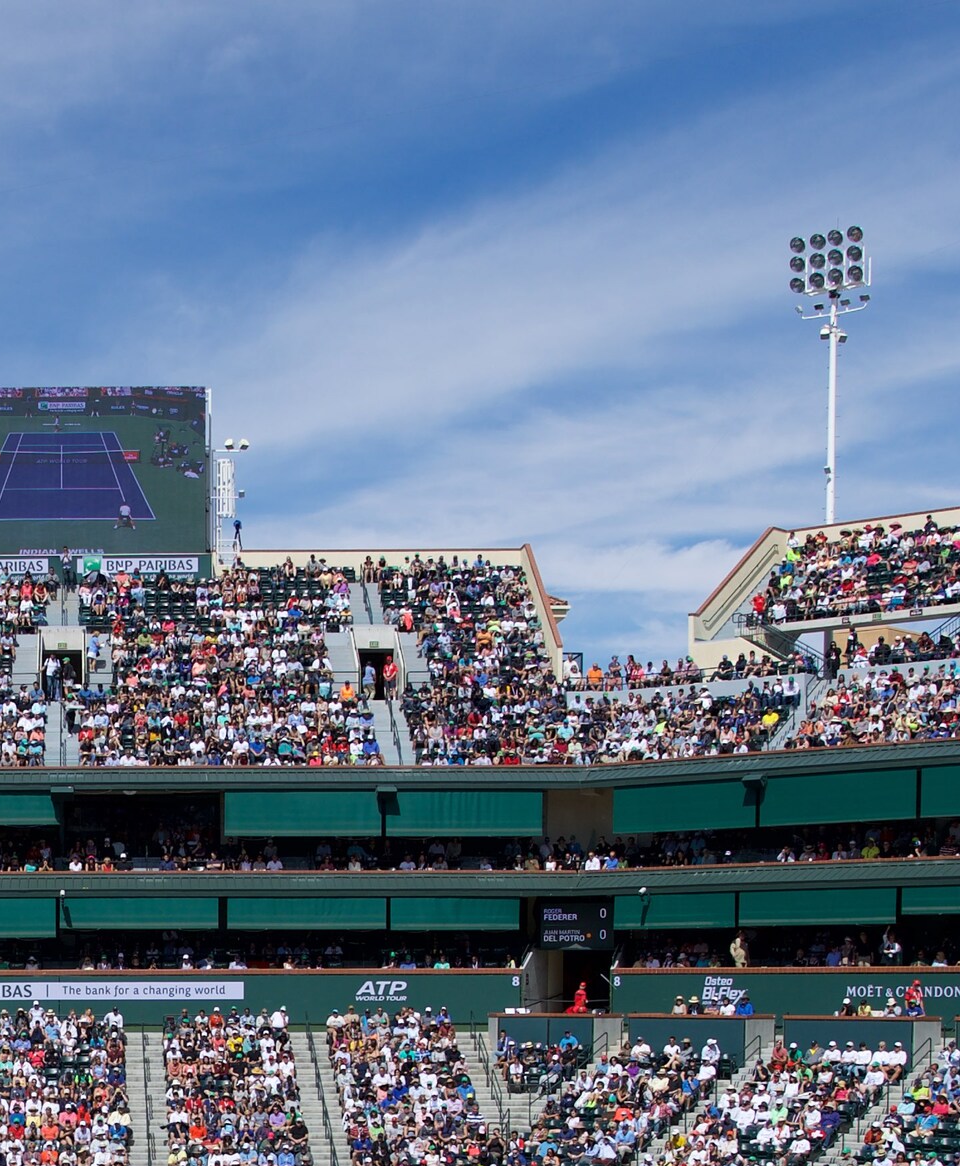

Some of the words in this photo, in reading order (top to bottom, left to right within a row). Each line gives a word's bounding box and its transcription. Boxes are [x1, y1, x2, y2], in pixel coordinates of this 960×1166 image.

[106, 560, 133, 572] BNP
[140, 560, 193, 571] PARIBAS
[599, 908, 607, 918] 0
[599, 929, 607, 939] 0
[512, 976, 520, 987] 8
[613, 976, 621, 987] 8
[704, 976, 733, 986] Osteo
[62, 985, 81, 995] The
[85, 985, 111, 995] bank
[114, 985, 129, 997] for
[143, 985, 191, 997] changing
[195, 985, 226, 995] world
[356, 981, 408, 995] ATP
[886, 987, 893, 997] &
